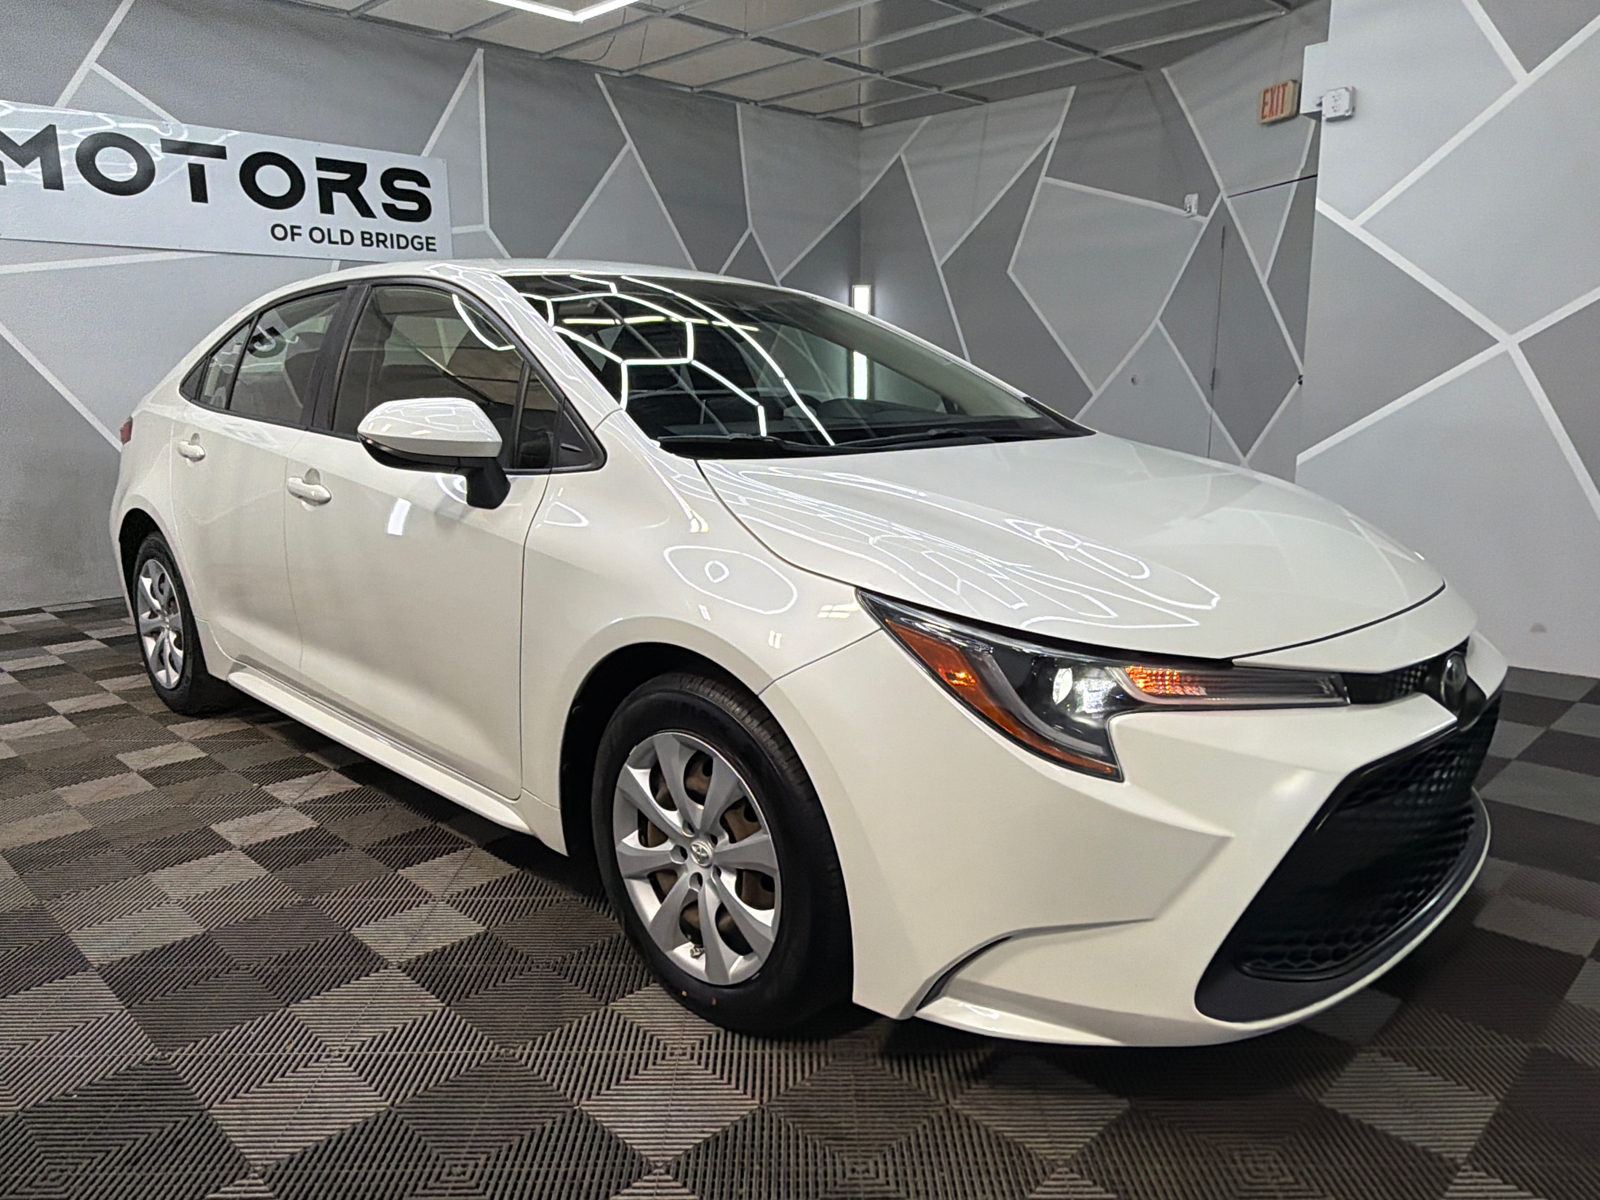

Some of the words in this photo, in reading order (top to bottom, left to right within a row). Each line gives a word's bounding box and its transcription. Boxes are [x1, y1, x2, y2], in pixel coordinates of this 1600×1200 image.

[1260, 81, 1289, 120] EXIT
[0, 124, 433, 223] MOTORS
[270, 223, 302, 242] OF
[308, 226, 355, 246] OLD
[360, 230, 438, 253] BRIDGE
